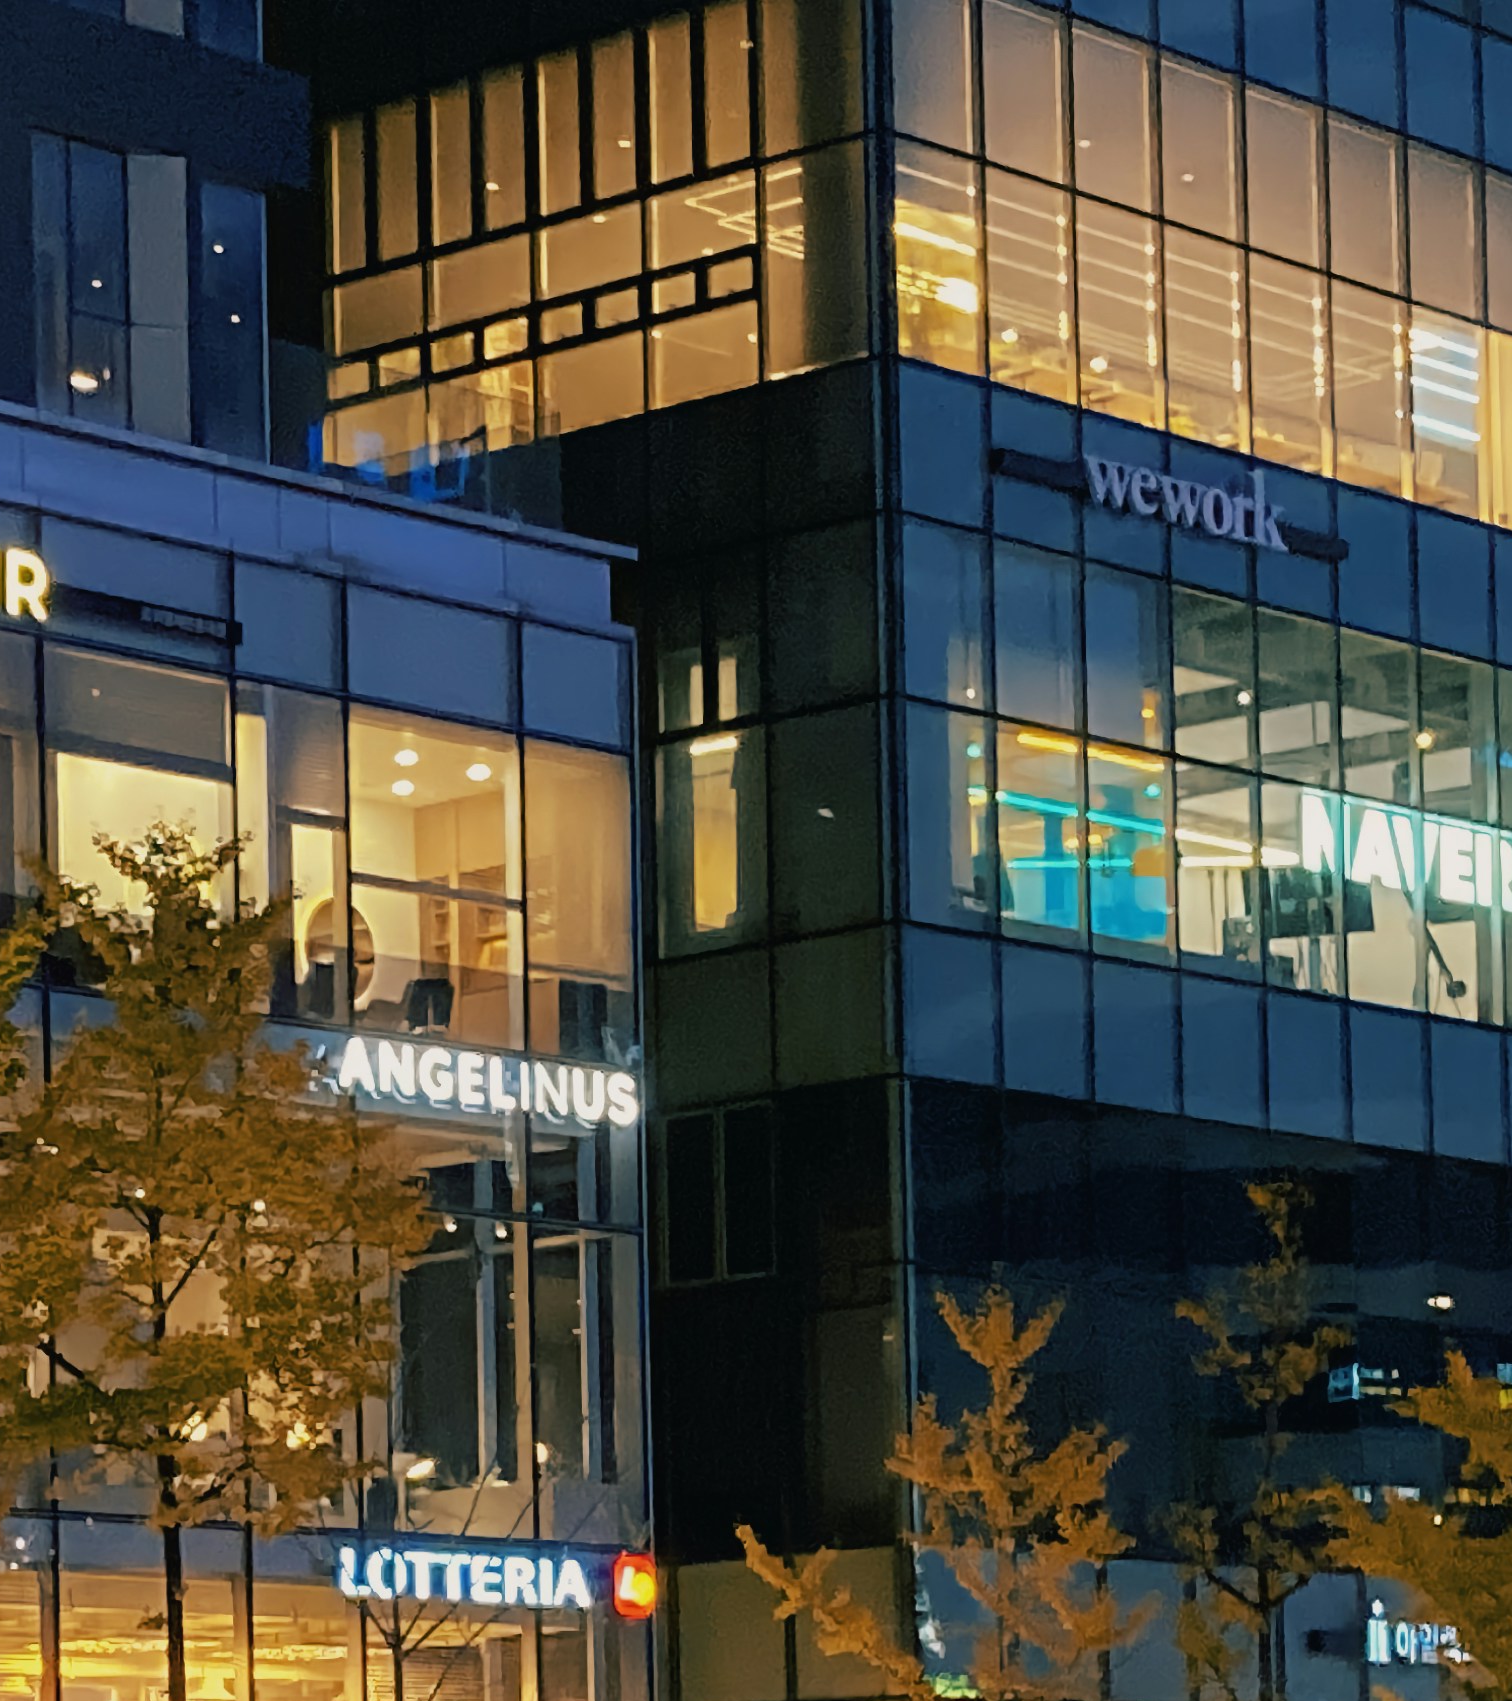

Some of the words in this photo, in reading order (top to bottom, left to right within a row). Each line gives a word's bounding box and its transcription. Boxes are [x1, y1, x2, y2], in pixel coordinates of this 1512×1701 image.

[1083, 454, 1290, 552] wework
[337, 1036, 639, 1128] ANGELINUS
[338, 1545, 592, 1609] LOTTERIA
